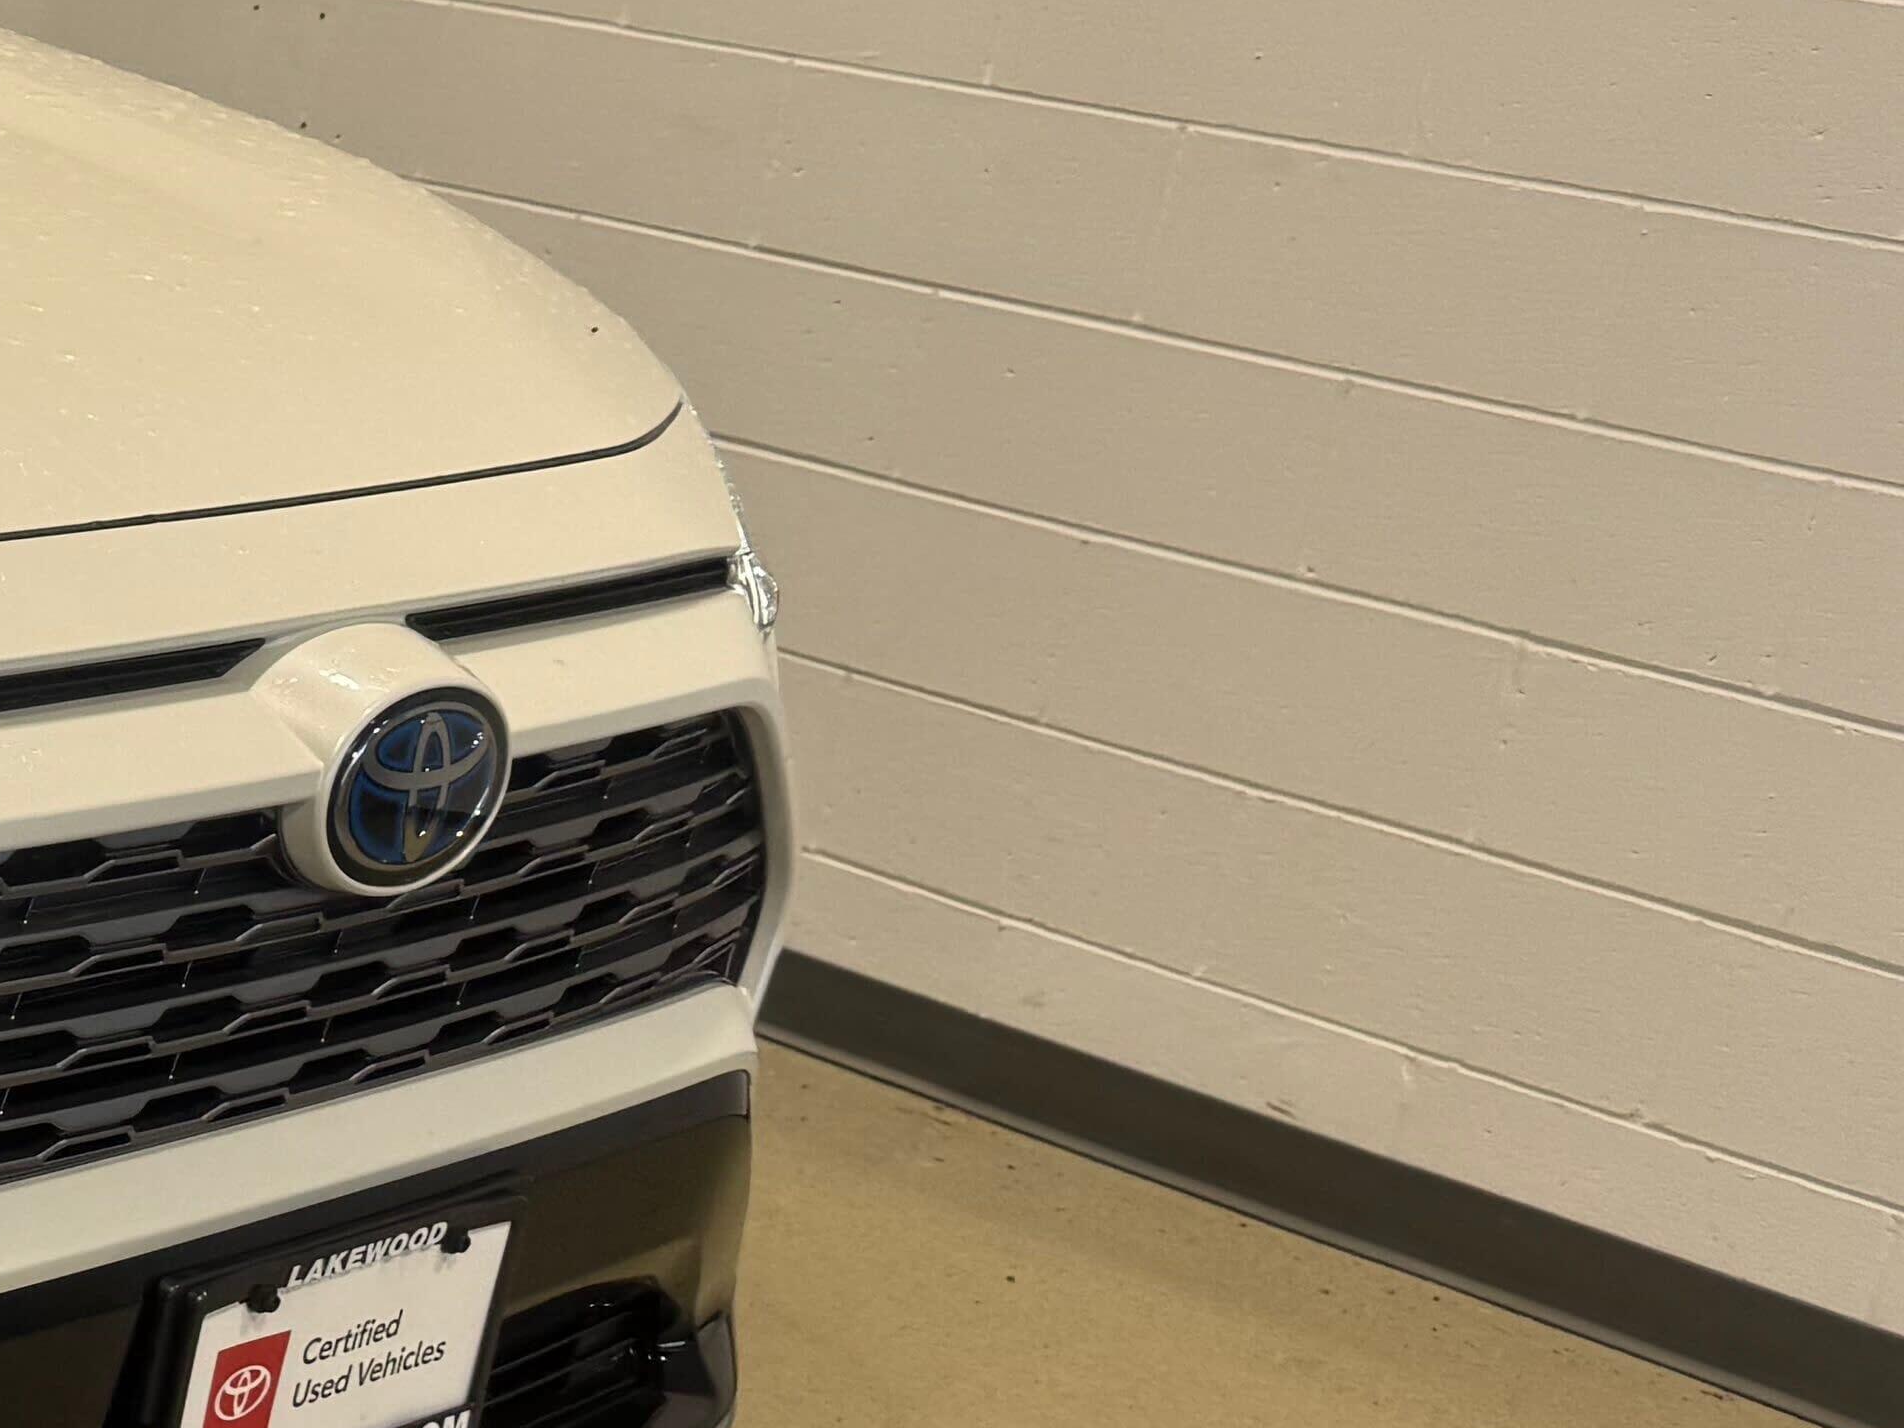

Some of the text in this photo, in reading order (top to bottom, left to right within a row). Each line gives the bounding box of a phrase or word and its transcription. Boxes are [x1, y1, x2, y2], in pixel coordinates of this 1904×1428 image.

[286, 1220, 449, 1289] LAKEWOOD
[302, 1309, 404, 1365] Certified
[292, 1338, 447, 1408] Used Vehicles
